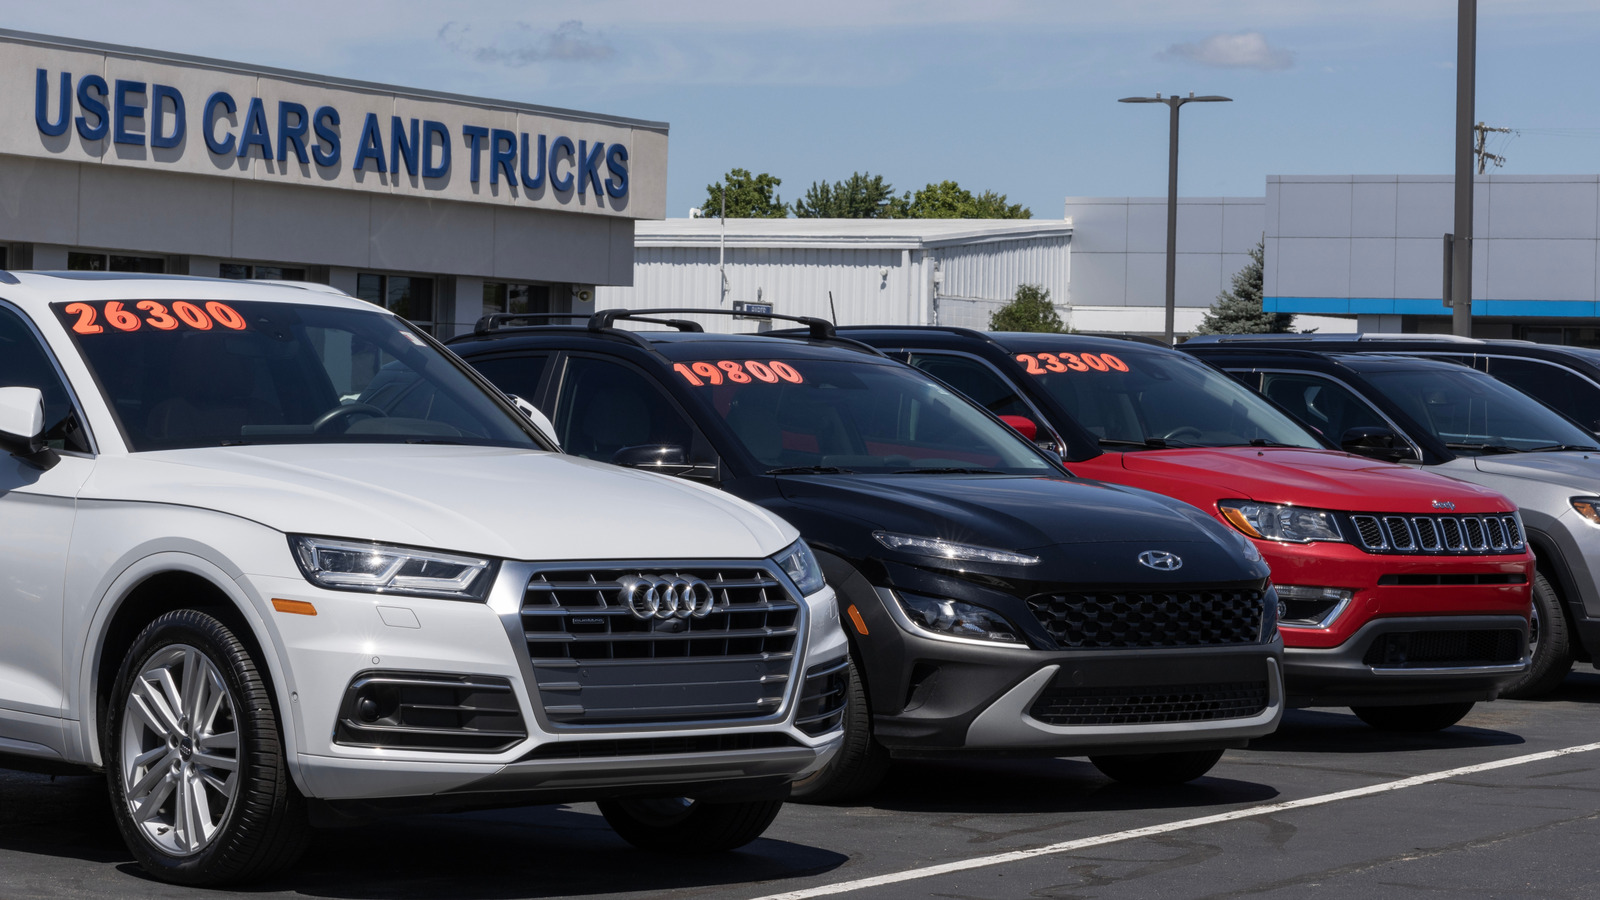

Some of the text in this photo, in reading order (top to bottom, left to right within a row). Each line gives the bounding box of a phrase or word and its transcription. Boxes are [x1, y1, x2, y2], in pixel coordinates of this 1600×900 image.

[36, 68, 629, 198] USED CARS AND TRUCKS
[65, 300, 247, 335] 26300
[673, 360, 804, 387] 19800
[1016, 352, 1130, 374] 23300
[1432, 499, 1456, 511] Jeep
